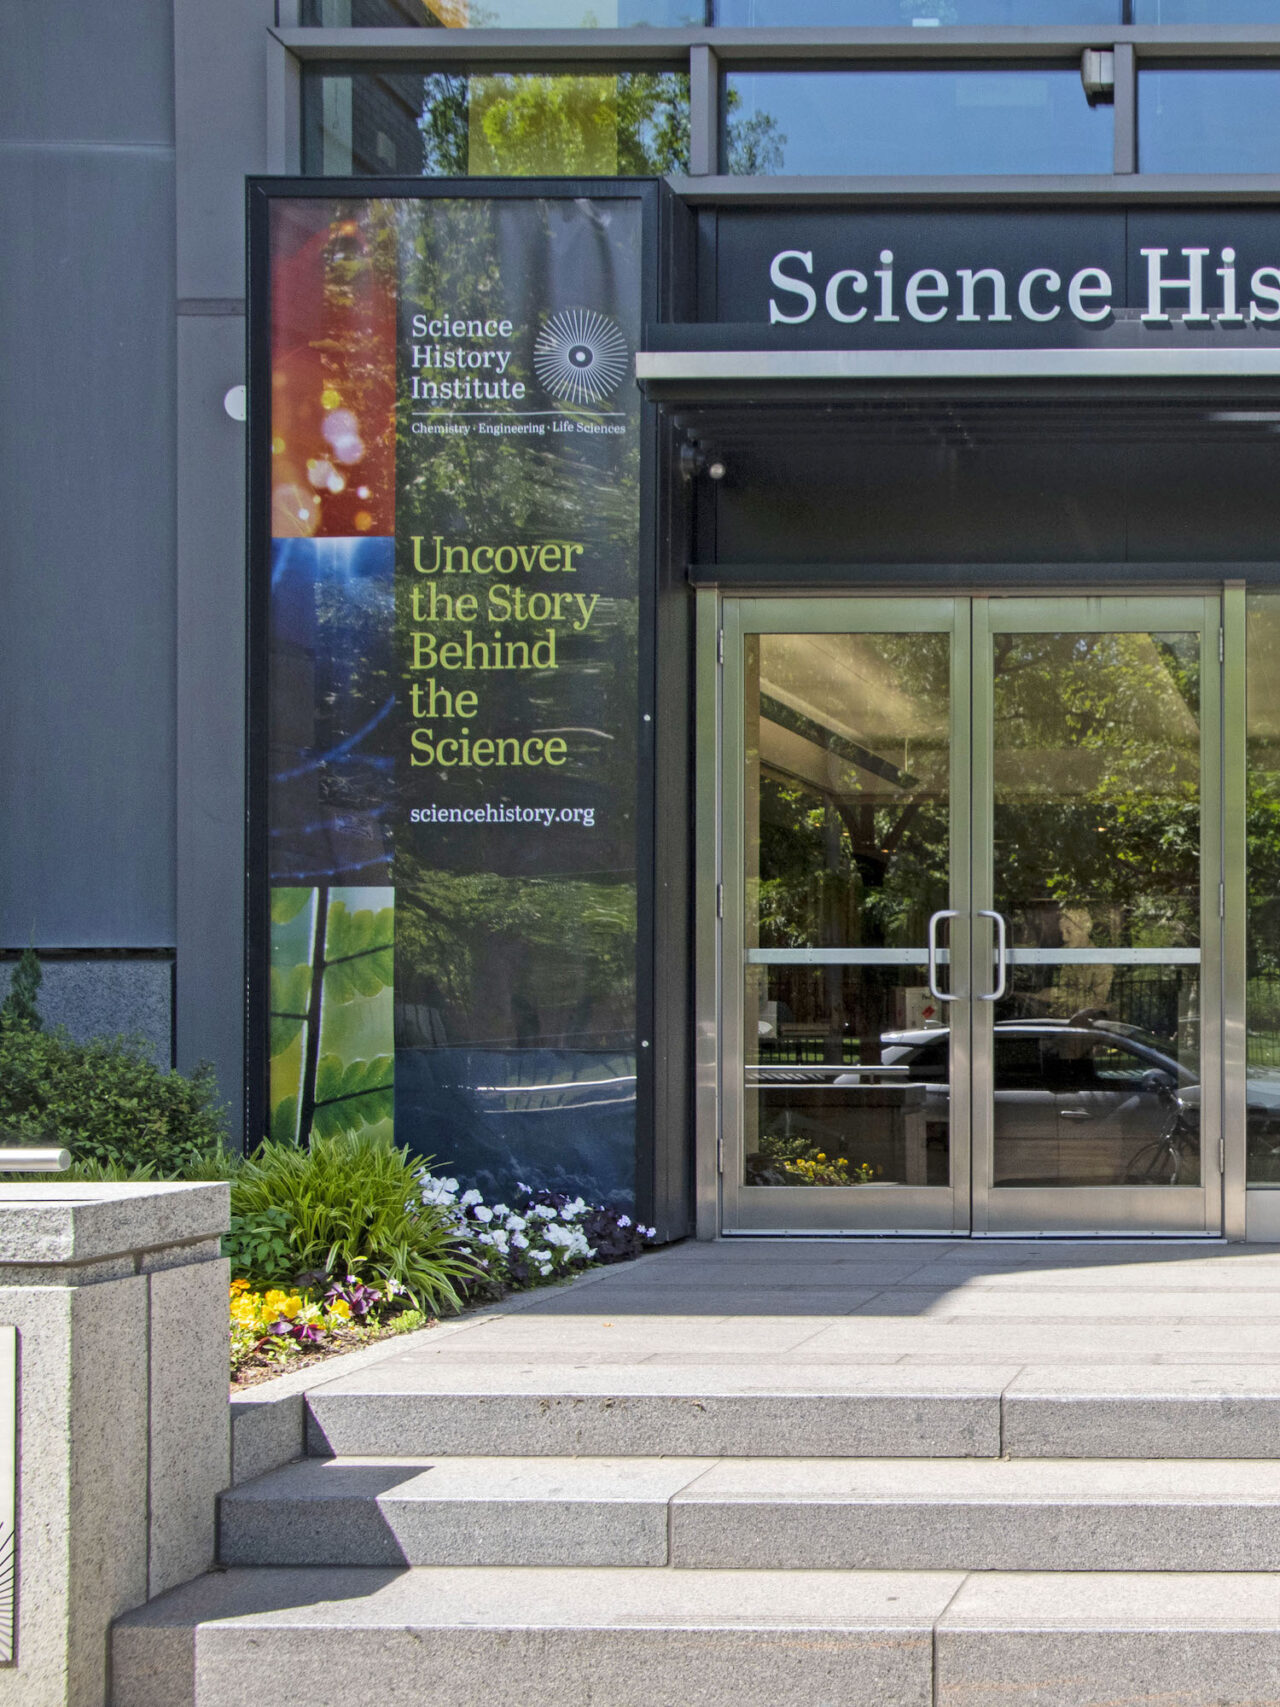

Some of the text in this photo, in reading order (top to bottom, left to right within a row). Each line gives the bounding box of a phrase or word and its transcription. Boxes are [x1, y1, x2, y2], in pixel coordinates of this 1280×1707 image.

[769, 249, 1112, 324] Science
[411, 313, 513, 338] Science
[411, 345, 511, 374] History
[411, 376, 526, 400] Institute
[411, 421, 626, 436] Chemistry Engineering Life Sciences
[410, 535, 584, 574] Uncover
[410, 582, 600, 631] the Story
[410, 629, 558, 670] Behind
[410, 678, 478, 718] the
[410, 727, 567, 767] Science
[410, 804, 595, 827] sciencehistory.org
